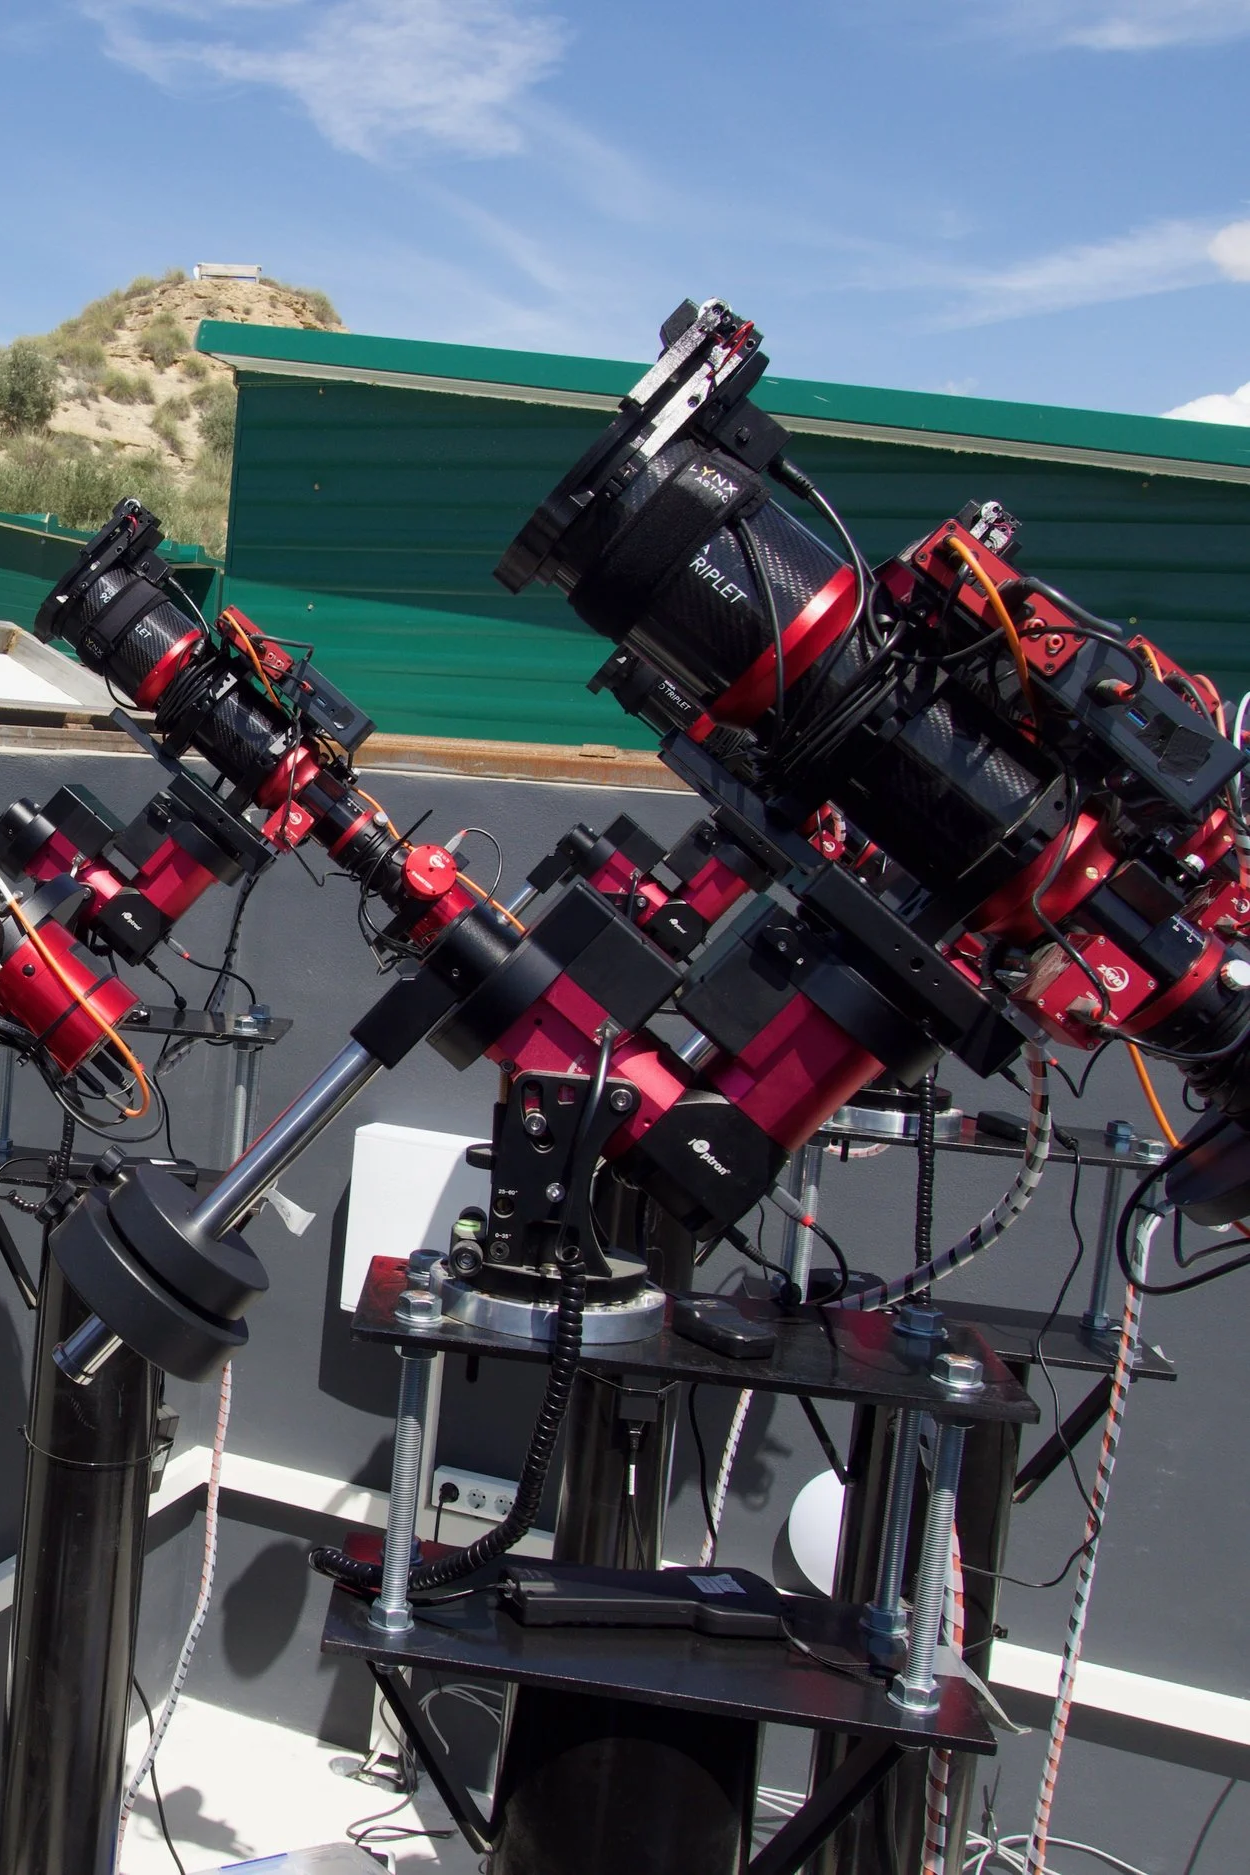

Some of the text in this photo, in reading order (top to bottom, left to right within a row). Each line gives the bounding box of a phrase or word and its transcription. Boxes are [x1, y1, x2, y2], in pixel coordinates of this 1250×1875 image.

[689, 463, 738, 497] LYNX
[694, 476, 728, 504] ASTRO
[689, 555, 748, 604] RIPLET
[664, 687, 692, 711] TRIPLET
[1096, 963, 1130, 992] ZWO
[687, 1138, 731, 1176] iOptron
